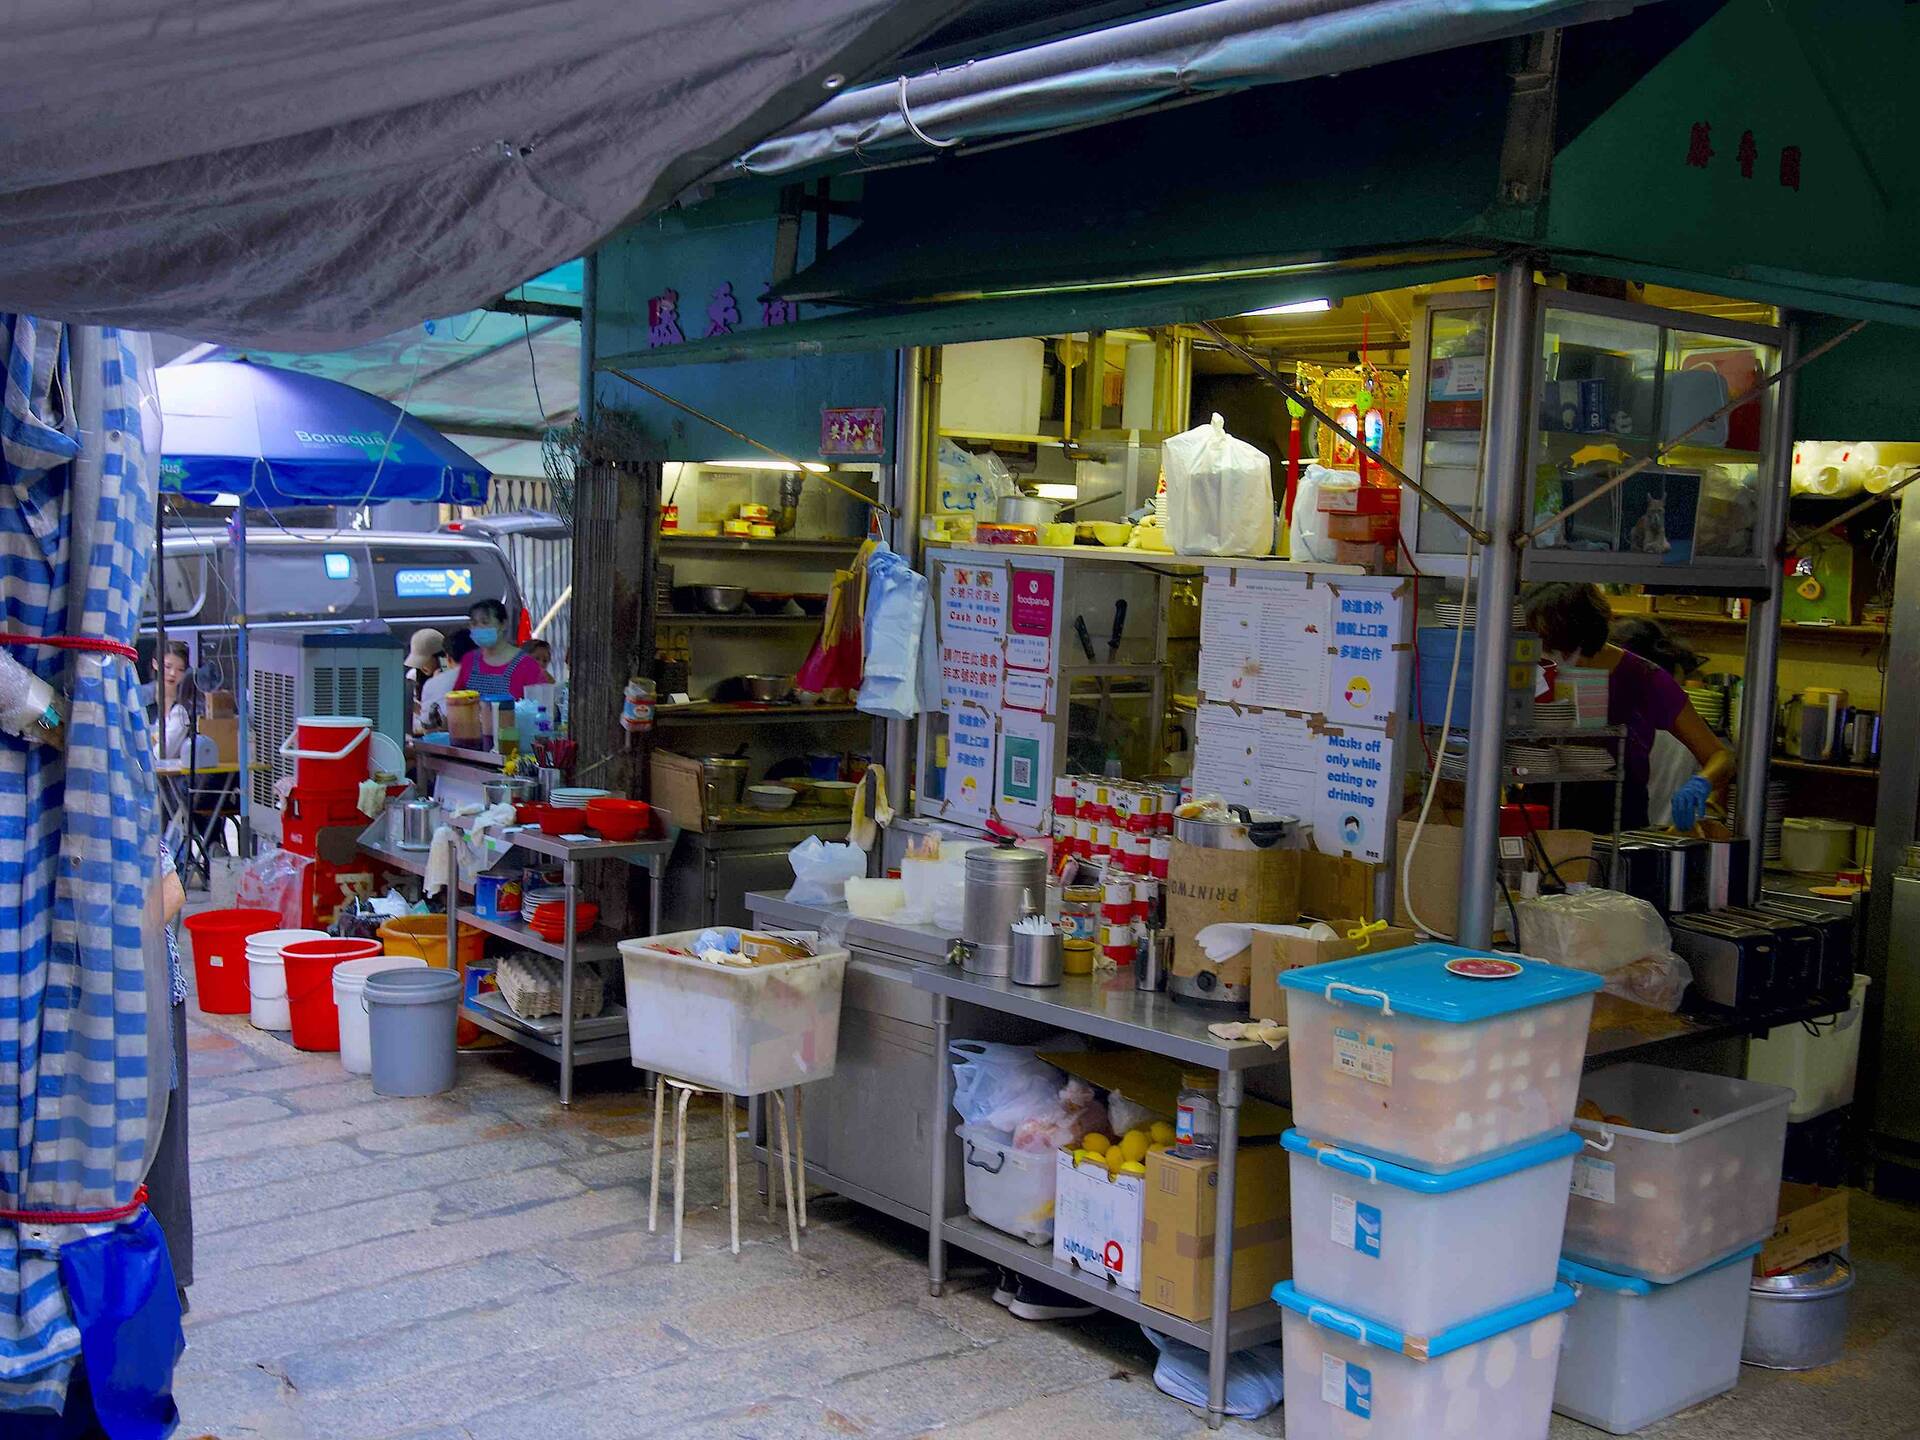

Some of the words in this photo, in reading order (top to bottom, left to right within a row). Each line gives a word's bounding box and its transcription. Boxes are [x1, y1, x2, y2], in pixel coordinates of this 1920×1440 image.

[294, 430, 386, 447] Bonaqua
[1017, 595, 1050, 607] foodpanda
[1341, 599, 1384, 616] 除進食外
[950, 611, 971, 623] Cash
[976, 614, 997, 627] Only
[1336, 621, 1388, 638] 請戴上口罩
[1340, 645, 1383, 661] 多謝合作
[1328, 735, 1362, 751] Masks
[1364, 739, 1381, 753] off
[1326, 754, 1350, 769] only
[1352, 757, 1382, 771] while
[1327, 772, 1363, 788] eating
[1365, 777, 1377, 788] or
[1327, 789, 1375, 808] drinking
